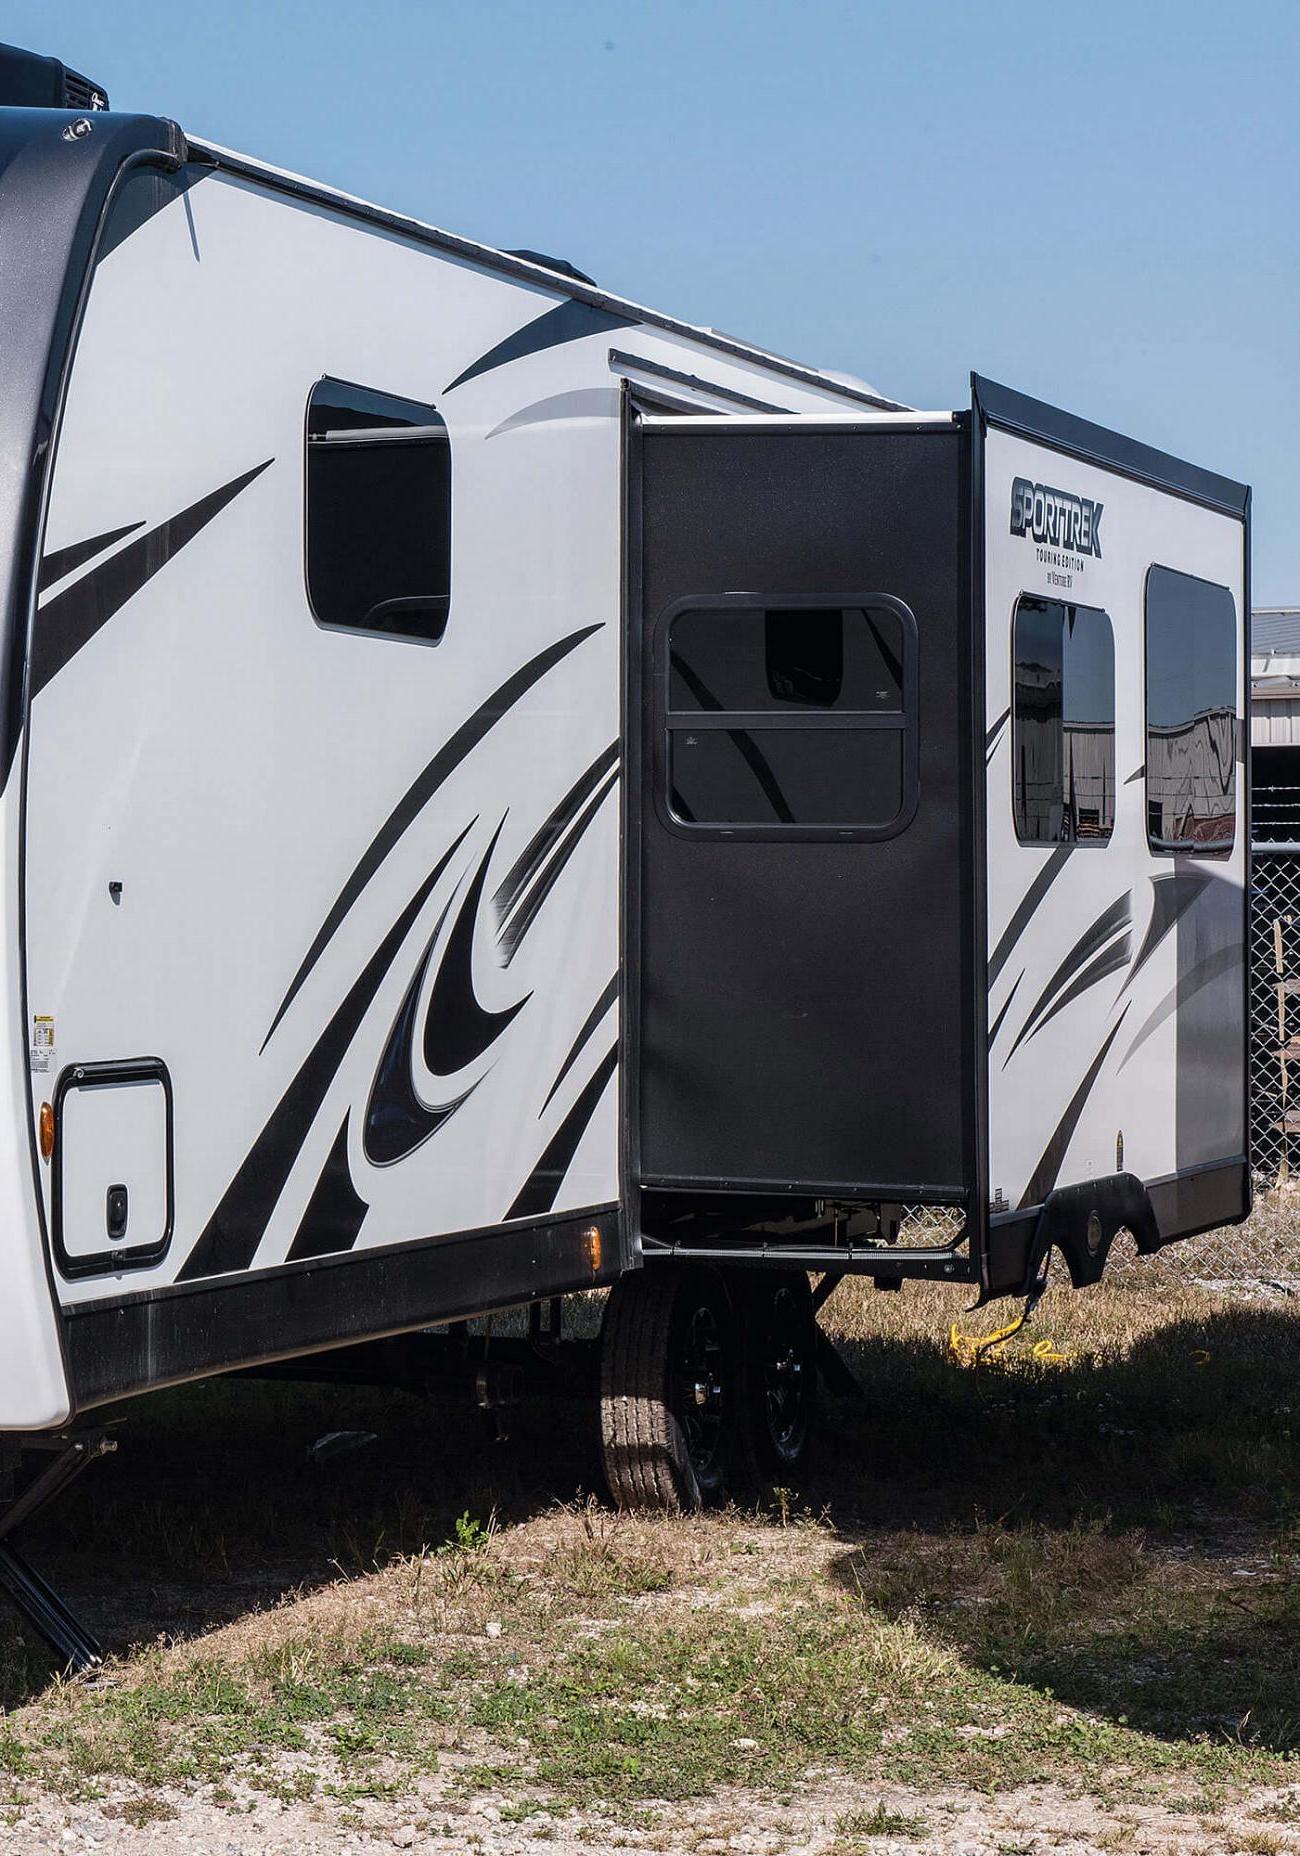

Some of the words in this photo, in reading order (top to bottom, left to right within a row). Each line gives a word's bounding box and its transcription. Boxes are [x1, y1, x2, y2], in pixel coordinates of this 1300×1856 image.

[1010, 477, 1104, 559] SPORTTREK
[1036, 548, 1061, 566] TOURING
[1062, 555, 1084, 572] EDITION
